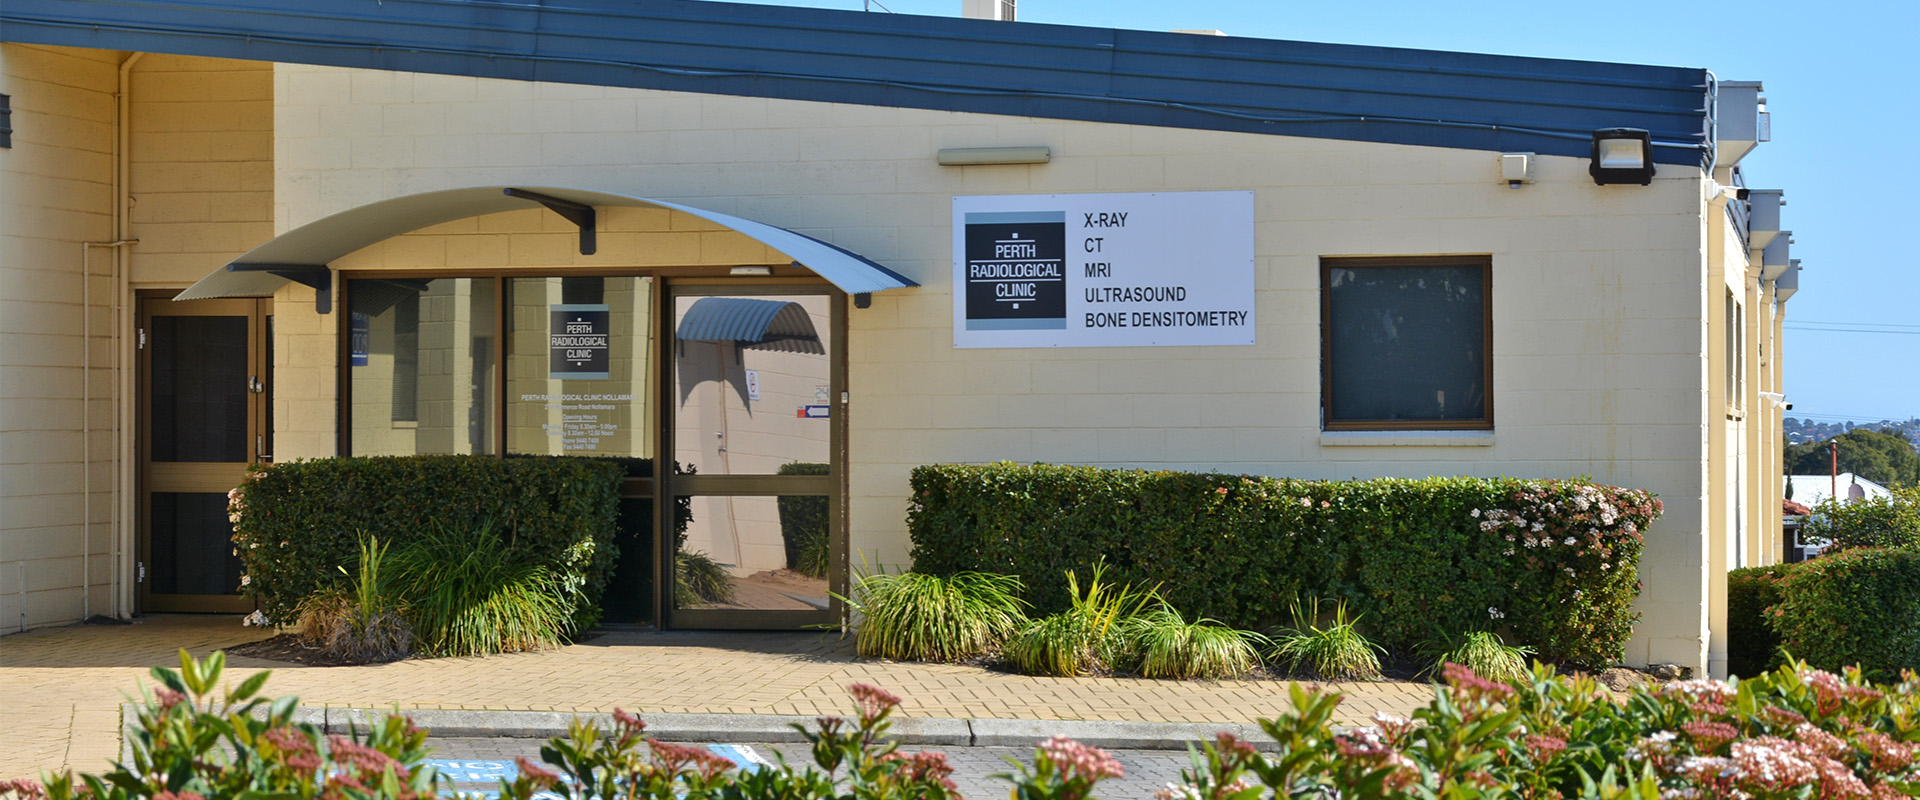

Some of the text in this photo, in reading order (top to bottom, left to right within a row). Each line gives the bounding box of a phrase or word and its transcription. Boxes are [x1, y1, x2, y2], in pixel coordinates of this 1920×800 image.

[1083, 212, 1129, 229] X-RAY
[995, 244, 1036, 258] PERTH
[1084, 237, 1104, 253] CT
[970, 262, 1062, 278] RADIOLOGICAL
[1084, 262, 1112, 278] MRI
[995, 282, 1036, 298] CLINIC
[1085, 286, 1187, 302] ULTRASOUND
[1085, 310, 1248, 328] BONE DENSITOMETRY
[566, 325, 592, 334] PERTH
[551, 337, 607, 346] RADIOLOGICAL
[566, 349, 592, 358] CLINIC
